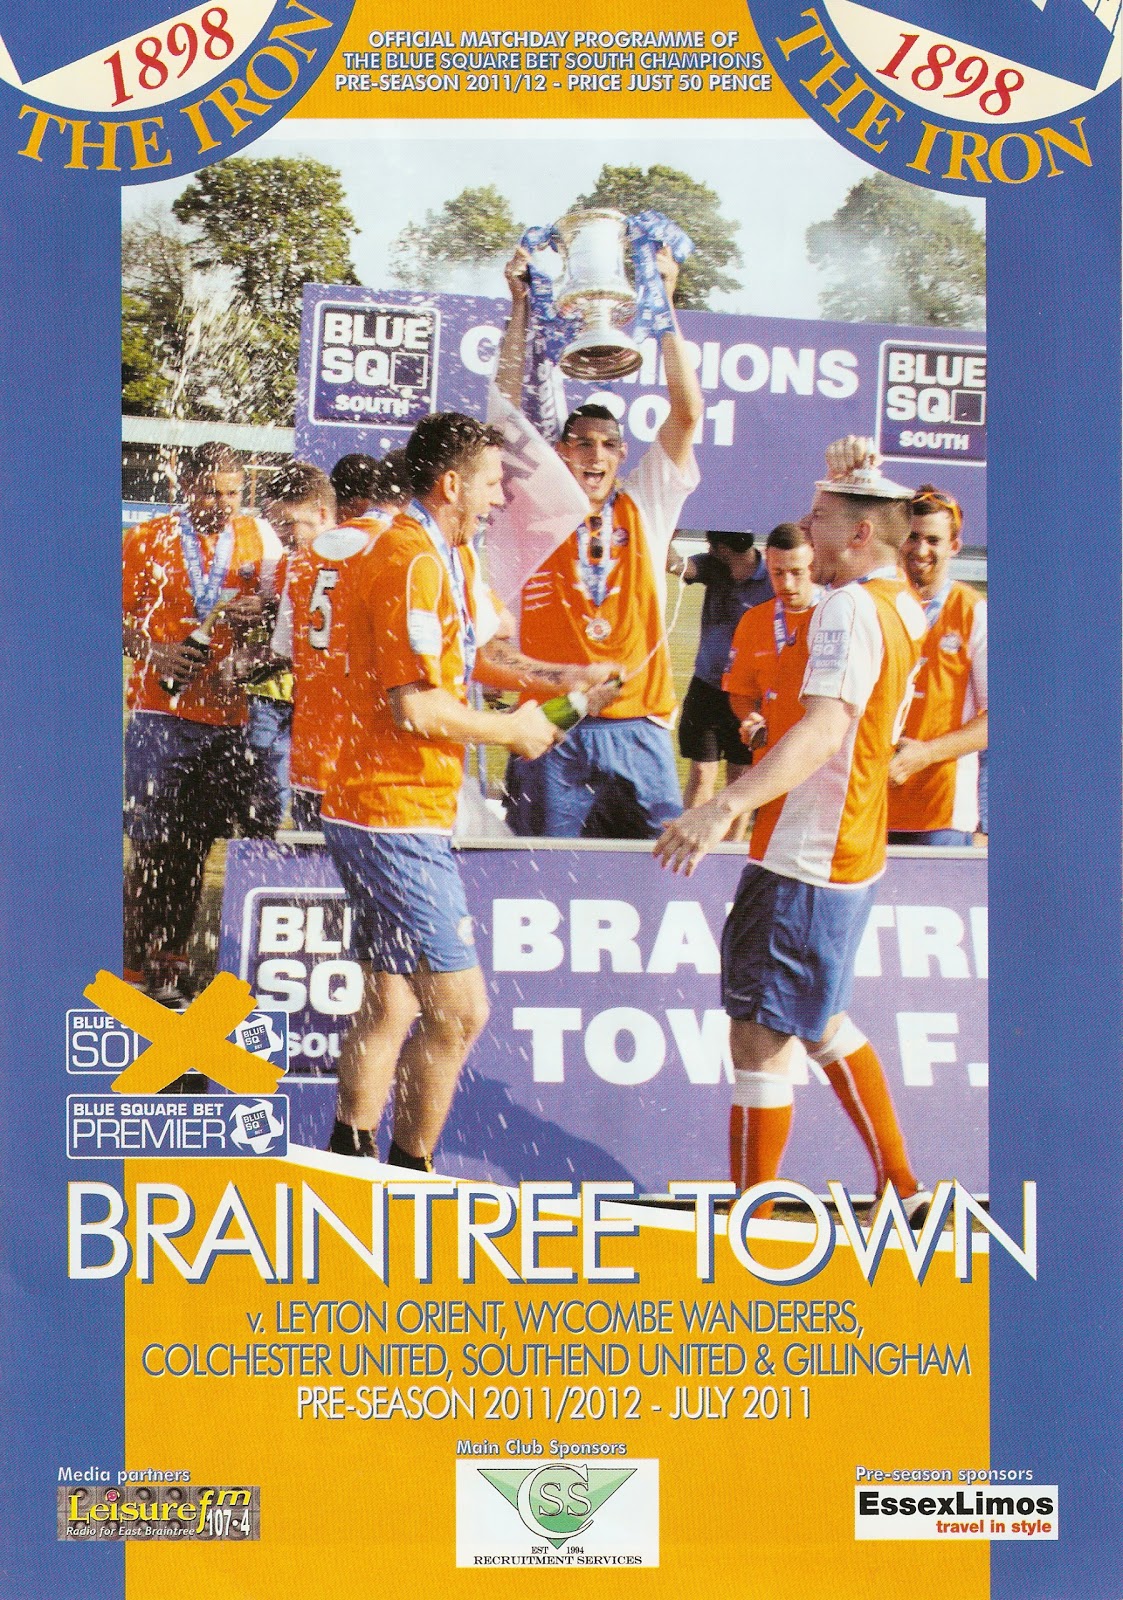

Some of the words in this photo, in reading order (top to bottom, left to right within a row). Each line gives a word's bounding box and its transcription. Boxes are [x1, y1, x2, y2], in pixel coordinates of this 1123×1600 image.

[368, 30, 455, 48] OFFICIAL
[460, 30, 570, 48] MATCHDAY
[574, 30, 705, 48] PROGRAMME
[710, 30, 739, 48] OF
[104, 7, 235, 107] 1898
[343, 52, 381, 70] THE
[386, 52, 436, 70] BLUE
[440, 52, 521, 72] SQUARE
[525, 52, 561, 70] BET
[565, 52, 635, 70] SOUTH
[640, 52, 764, 70] CHAMPIONS
[335, 74, 460, 91] PRE-SEASON
[466, 74, 547, 93] 2011/12
[568, 74, 621, 91] PRICE
[627, 74, 674, 91] JUST
[678, 74, 703, 91] 50
[709, 74, 772, 91] PENCE
[876, 32, 1025, 116] 1898
[17, 105, 172, 171] THE
[179, 0, 334, 154] IRON
[773, 10, 905, 154] THE
[906, 117, 1094, 184] IRON
[323, 312, 432, 350] BLUE
[321, 348, 392, 386] SQ
[888, 352, 986, 387] BLUE
[335, 394, 409, 416] SOUTH
[886, 385, 951, 423] SQ
[899, 430, 968, 451] SOUTH
[308, 568, 338, 650] 5
[255, 959, 364, 1015] SQ
[73, 1017, 114, 1029] BLUE
[243, 1025, 265, 1038] BLUE
[245, 1036, 260, 1046] SQ
[74, 1103, 114, 1116] BLUE
[121, 1103, 187, 1116] SQUARE
[193, 1103, 223, 1116] BET
[243, 1111, 266, 1124] BLUE
[73, 1118, 225, 1149] PREMIER
[245, 1121, 260, 1131] SQ
[67, 1180, 639, 1284] BRAINTREE
[669, 1178, 1037, 1285] TOWN
[276, 1300, 388, 1334] LEYTON
[396, 1300, 505, 1339] ORIENT,
[514, 1300, 673, 1334] WYCOMBE
[680, 1300, 864, 1339] WANDERERS,
[141, 1343, 333, 1377] COLCHESTER
[340, 1343, 453, 1382] UNITED,
[461, 1343, 630, 1377] SOUTHEND
[638, 1343, 747, 1377] UNITED
[756, 1343, 776, 1377] &
[783, 1343, 971, 1377] GILLINGHAM
[296, 1386, 475, 1420] PRE-SEASON
[483, 1386, 641, 1424] 2011/2012
[669, 1386, 734, 1420] JULY
[741, 1386, 811, 1420] 2011
[456, 1439, 500, 1455] Main
[505, 1439, 544, 1455] Club
[549, 1439, 627, 1459] Sponsors
[57, 1466, 111, 1482] Media
[117, 1467, 191, 1485] partners
[855, 1466, 953, 1482] Pre-season
[958, 1469, 1034, 1485] sponsors
[68, 1489, 197, 1525] Leisure
[196, 1489, 251, 1534] fm
[859, 1491, 1054, 1516] EssexLimos
[66, 1526, 97, 1537] Radio
[99, 1526, 116, 1537] for
[118, 1526, 142, 1537] East
[144, 1526, 195, 1537] Braintree
[936, 1519, 984, 1533] travel
[990, 1519, 1005, 1533] in
[1011, 1519, 1052, 1536] style
[473, 1556, 574, 1565] RECRUITMENT
[576, 1556, 642, 1565] SERVICES
[531, 1546, 549, 1554] EST
[566, 1546, 585, 1554] 1994
